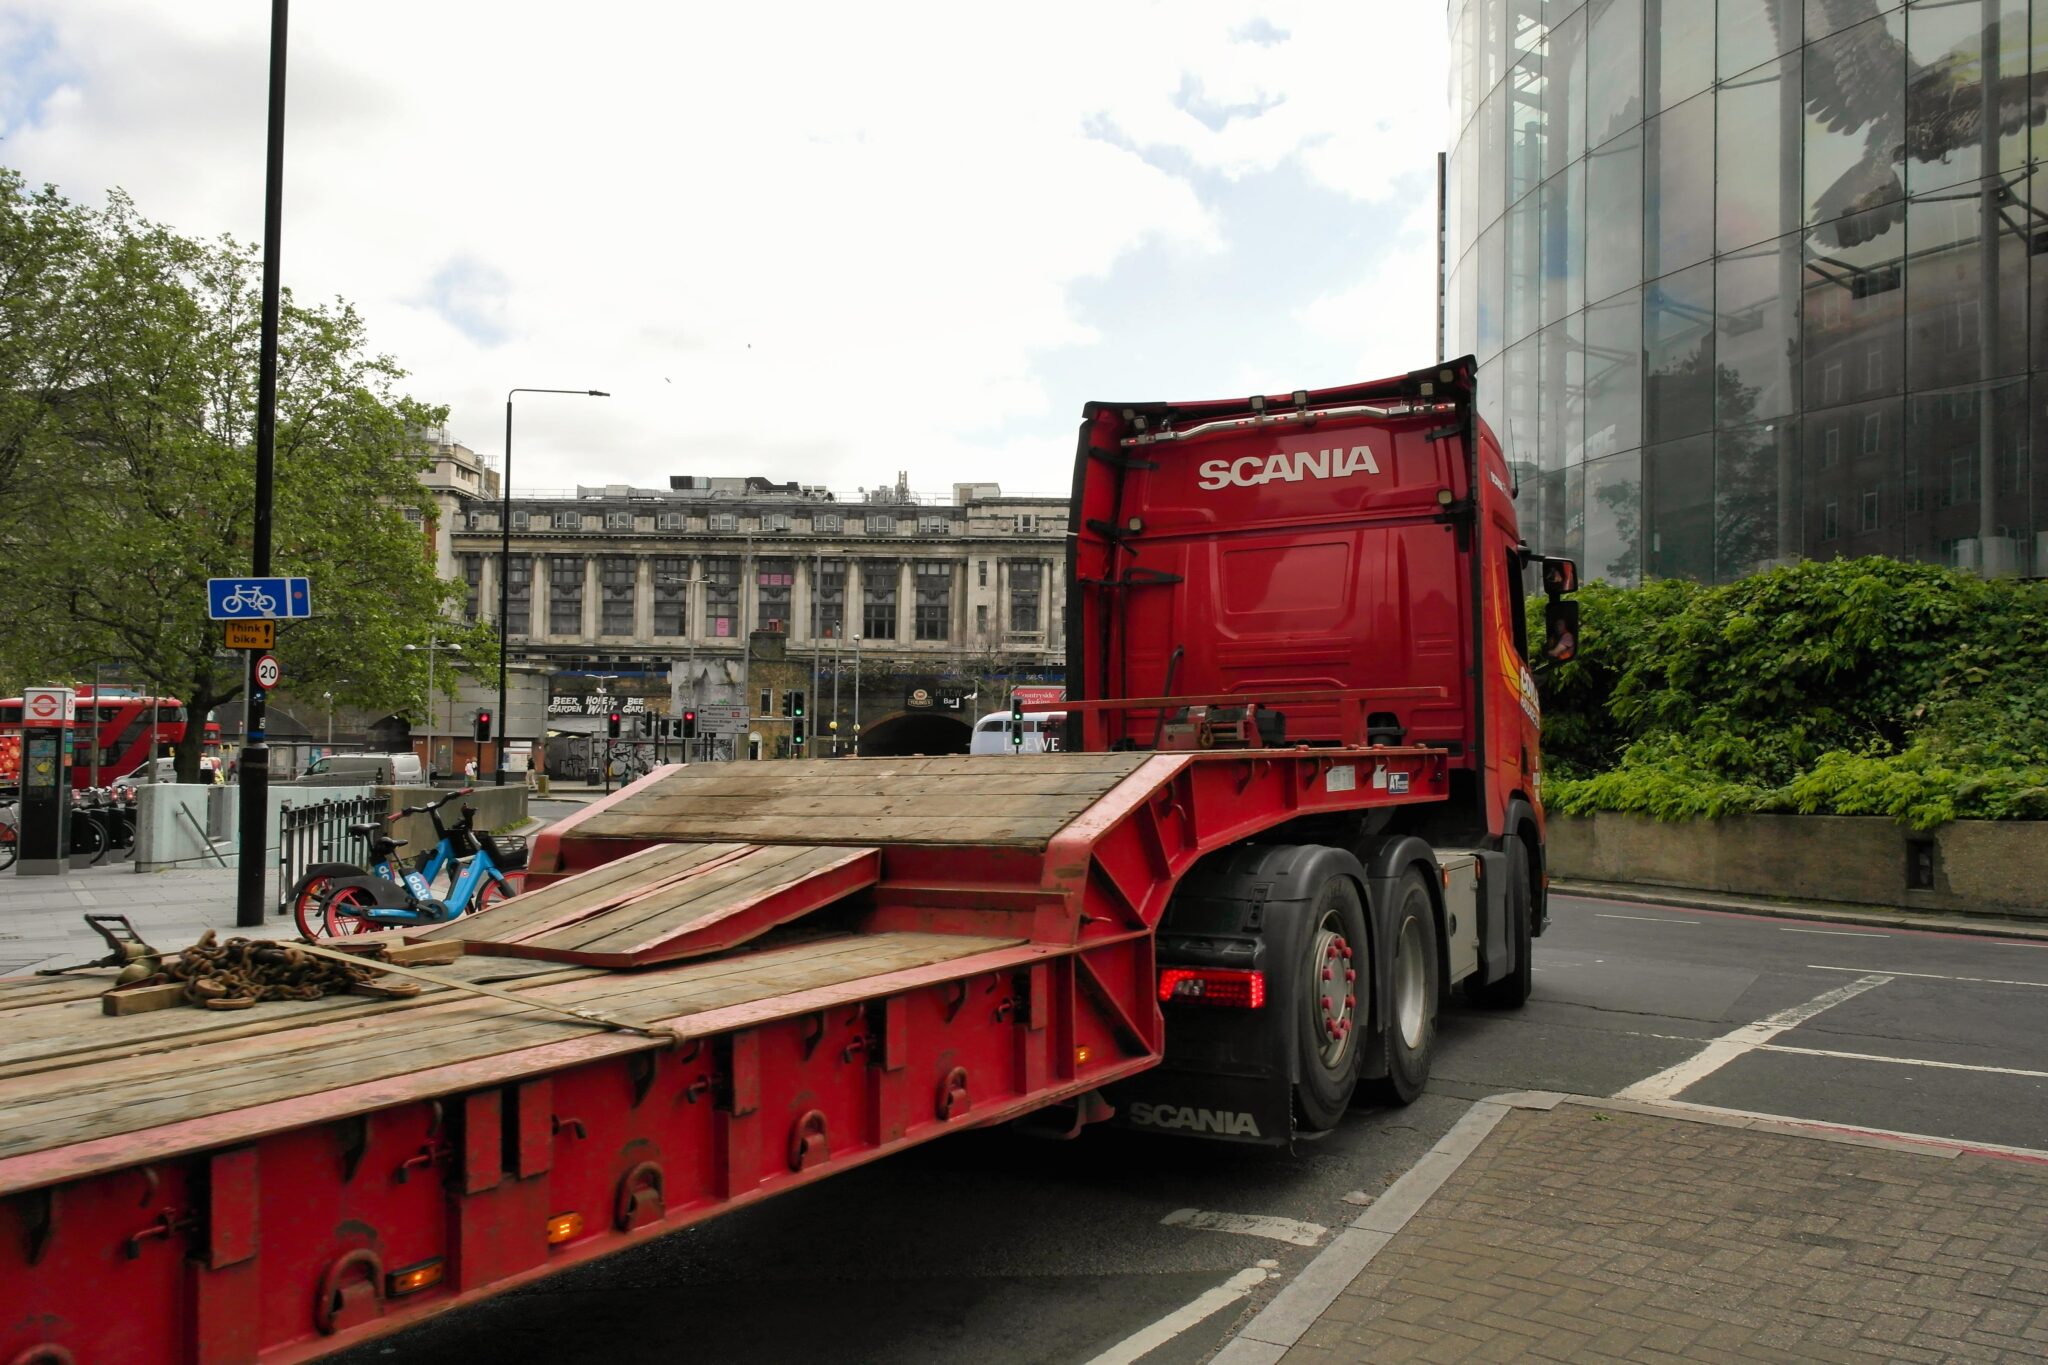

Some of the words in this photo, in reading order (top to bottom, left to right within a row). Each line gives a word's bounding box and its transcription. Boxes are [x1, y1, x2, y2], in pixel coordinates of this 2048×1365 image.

[1198, 445, 1379, 491] SCANIA
[231, 624, 261, 632] Think
[234, 635, 257, 643] bike
[260, 665, 277, 679] 20
[553, 697, 579, 705] BEER
[943, 697, 956, 705] Bar
[548, 705, 582, 713] GARDEN
[1004, 738, 1059, 752] LEWE
[409, 876, 429, 901] dott
[1129, 1101, 1261, 1137] SCANIA
